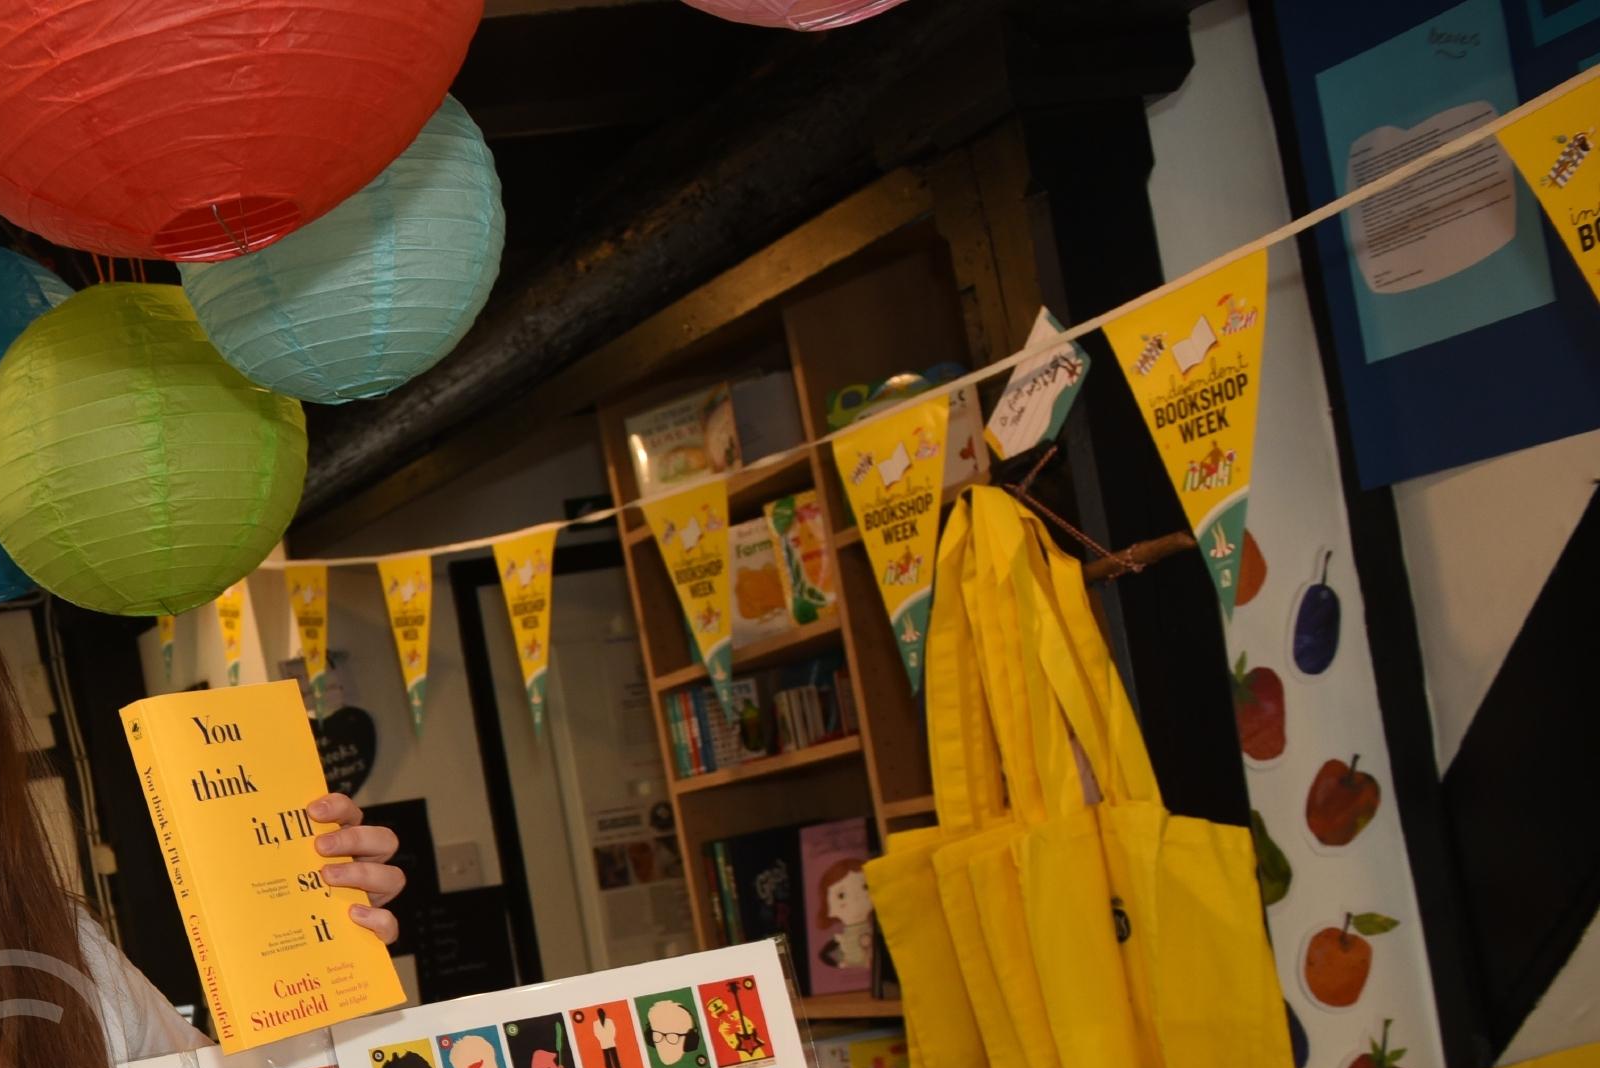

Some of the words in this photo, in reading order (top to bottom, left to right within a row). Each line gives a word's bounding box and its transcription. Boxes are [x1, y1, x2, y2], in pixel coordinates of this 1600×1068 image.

[1155, 372, 1249, 429] BOOKSHOP
[1178, 407, 1231, 444] WEEK
[864, 493, 934, 532] BOOKSHOP
[882, 521, 919, 546] WEEK
[192, 716, 243, 746] You
[191, 764, 258, 802] think
[251, 817, 281, 850] it,
[142, 765, 157, 793] You
[151, 796, 168, 830] think
[172, 866, 187, 889] say
[188, 914, 208, 963] Curtis
[205, 965, 235, 1040] Sittenfeld
[311, 914, 334, 943] it
[273, 972, 321, 999] Curtis
[250, 993, 329, 1032] Sittenfeld
